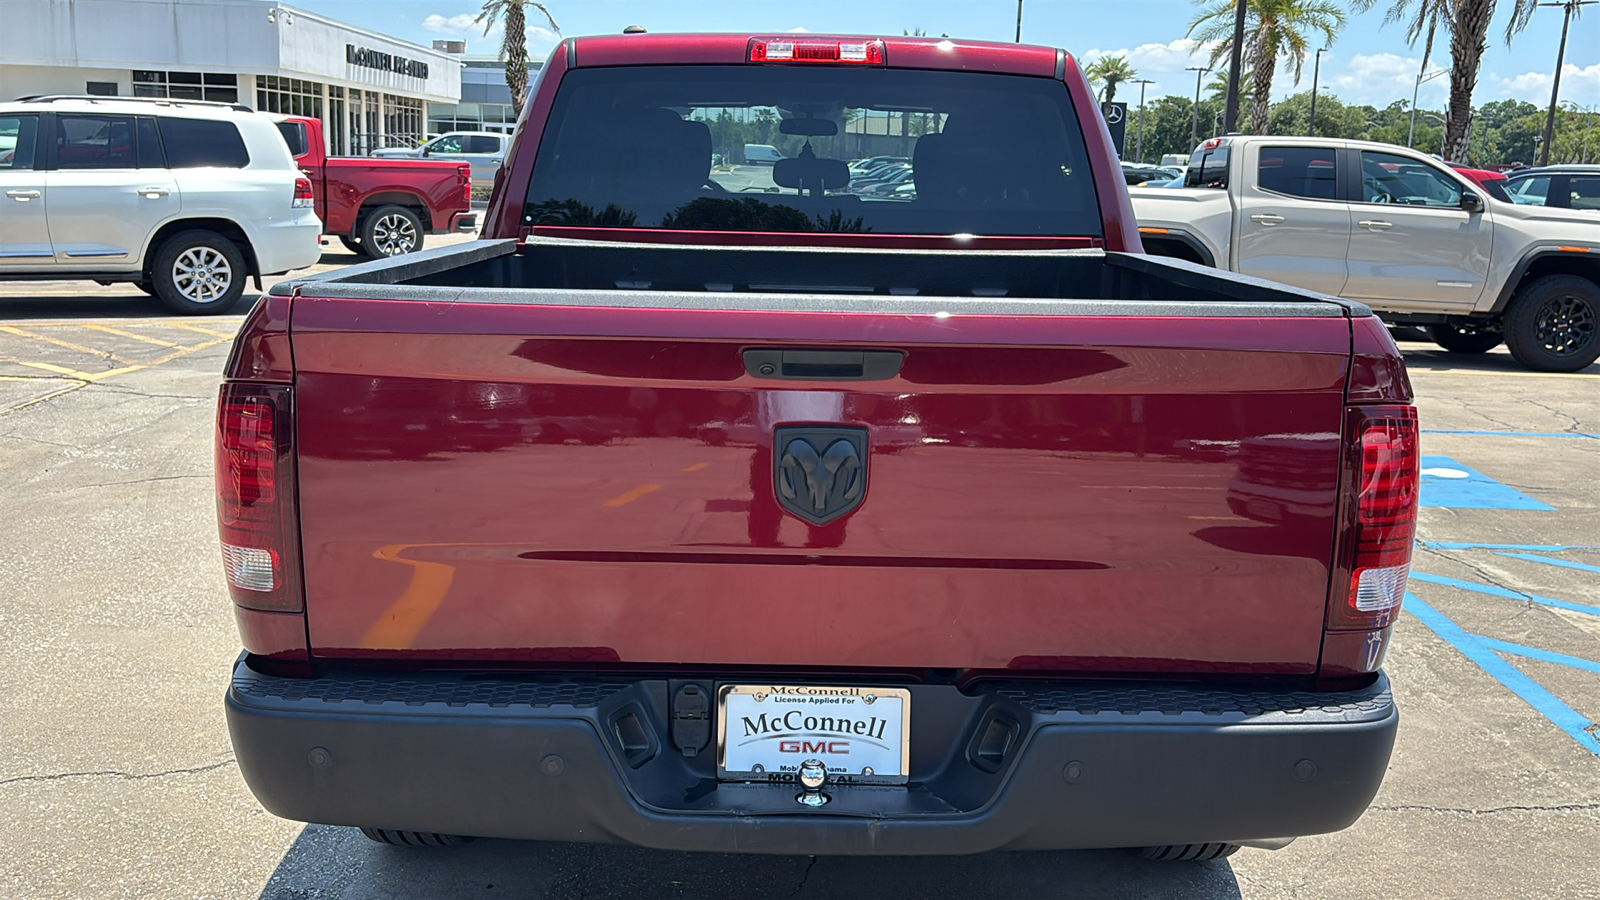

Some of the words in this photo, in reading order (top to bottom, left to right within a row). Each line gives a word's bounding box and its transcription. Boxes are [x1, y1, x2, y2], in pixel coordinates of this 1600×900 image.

[770, 686, 860, 696] McConnell
[774, 696, 807, 704] License
[808, 697, 840, 705] Applied
[841, 697, 856, 705] For
[741, 710, 887, 740] McConnell
[779, 740, 850, 755] GMC
